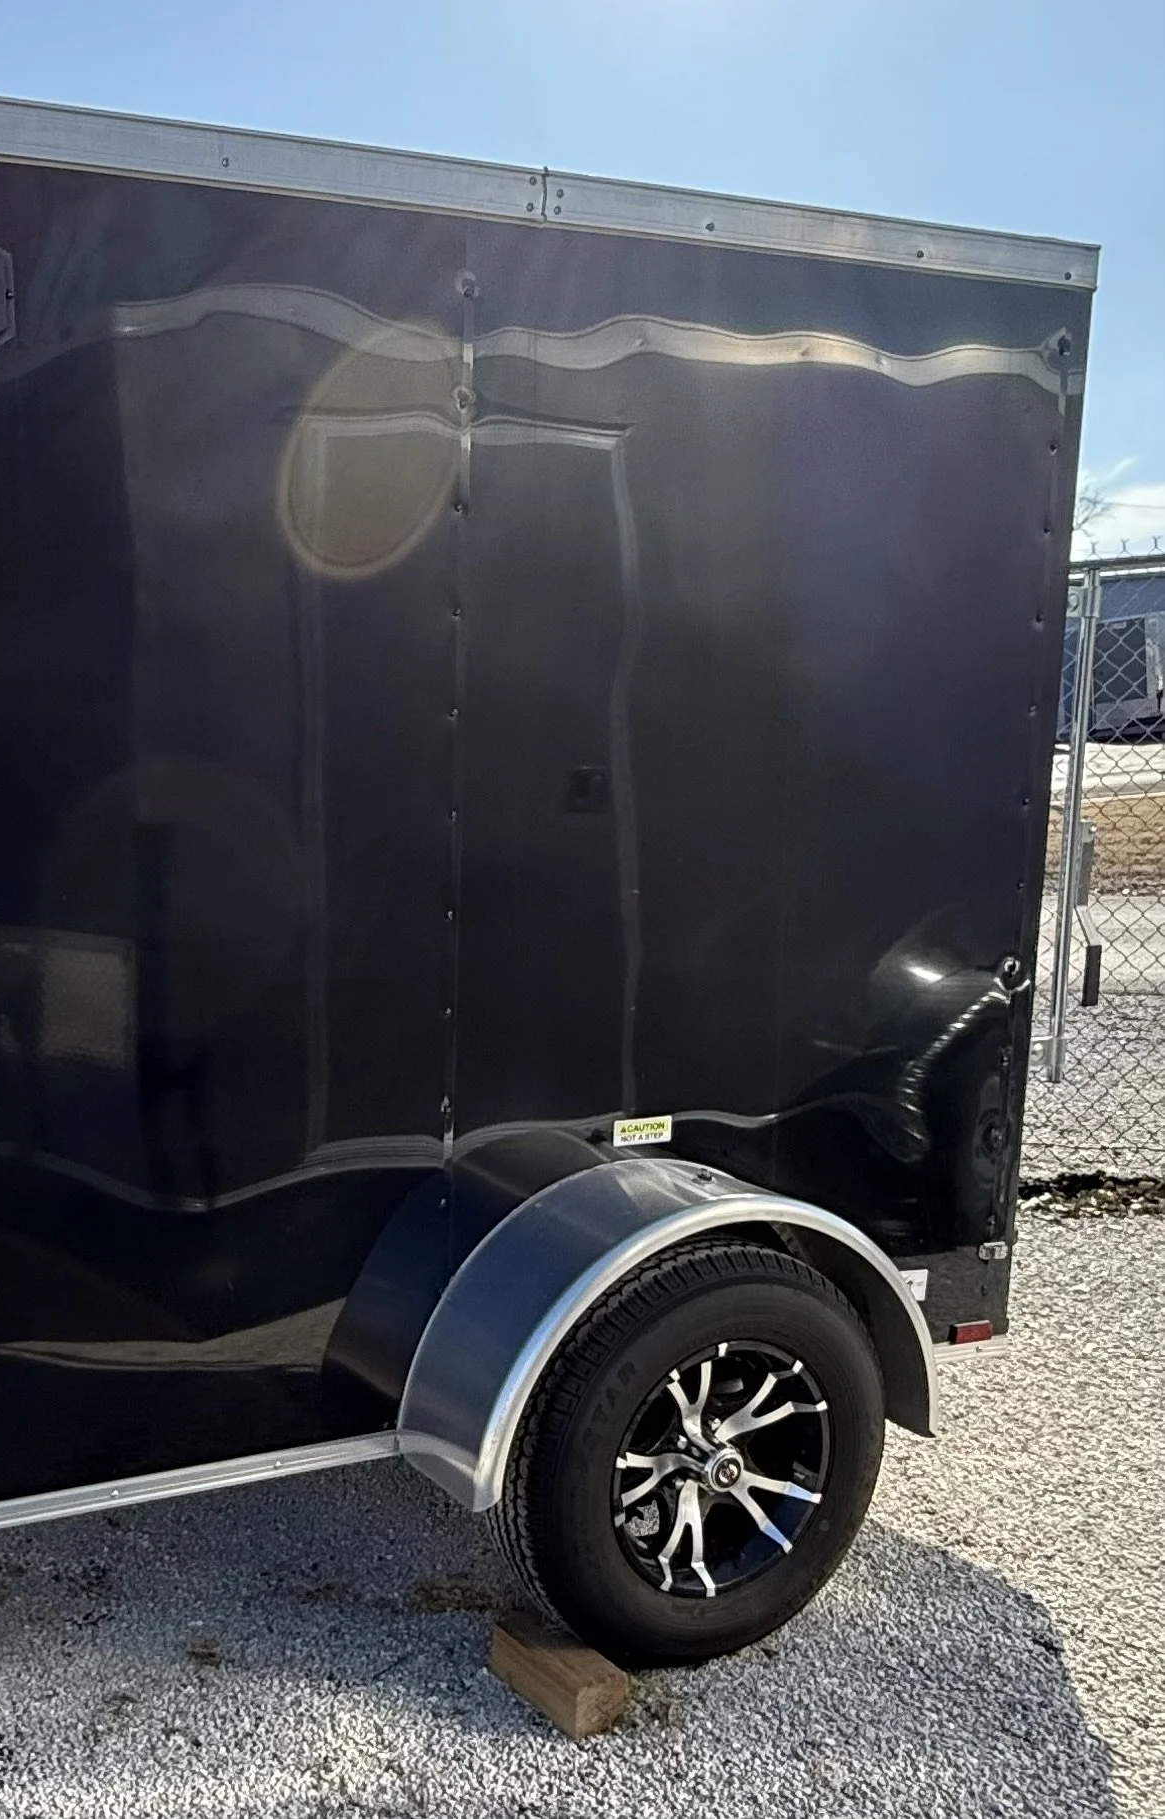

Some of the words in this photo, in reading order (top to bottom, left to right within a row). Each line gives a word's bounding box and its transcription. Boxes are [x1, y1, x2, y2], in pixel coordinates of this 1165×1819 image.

[627, 1121, 665, 1132] CAUTION
[620, 1133, 637, 1143] NOT
[644, 1132, 664, 1140] STEP
